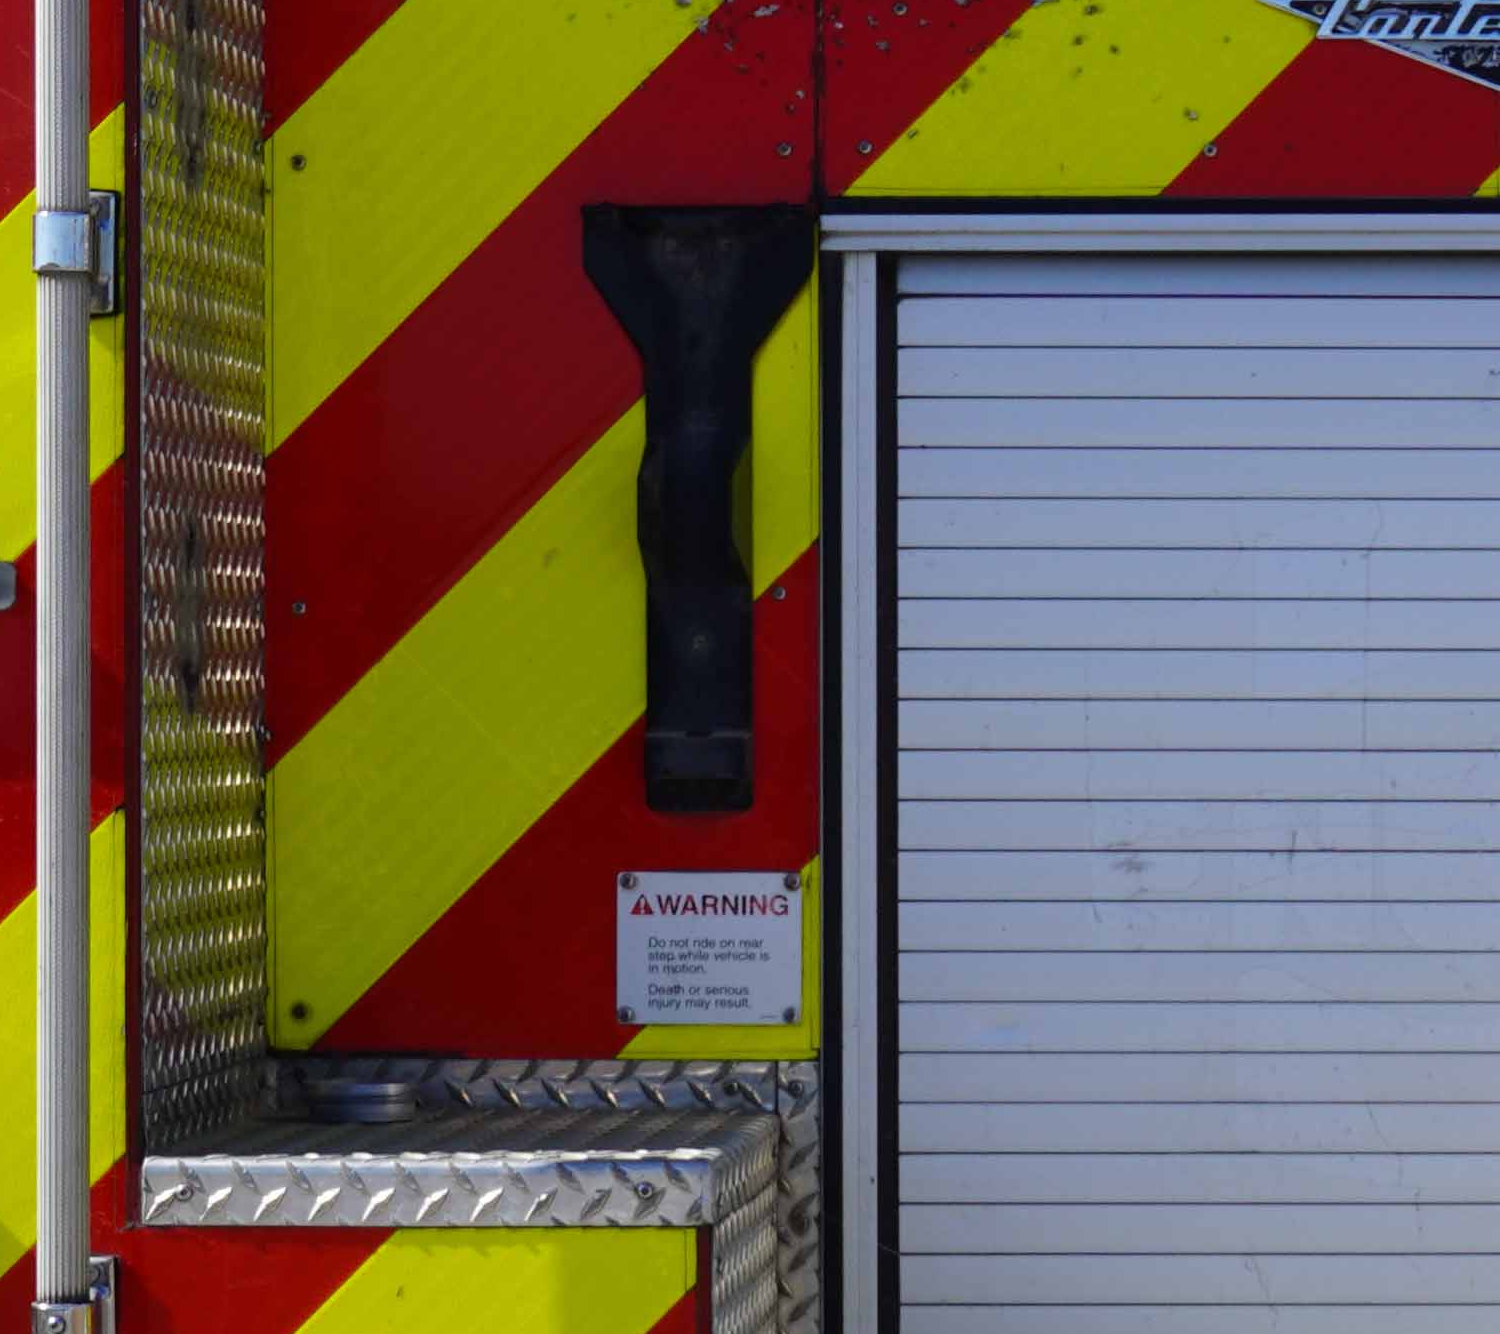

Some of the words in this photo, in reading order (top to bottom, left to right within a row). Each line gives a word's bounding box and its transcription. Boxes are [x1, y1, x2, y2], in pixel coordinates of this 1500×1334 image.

[656, 893, 789, 916] WARNING
[648, 937, 666, 948] Do
[669, 937, 689, 948] not
[692, 937, 716, 948] ride
[719, 939, 736, 948] on
[678, 950, 710, 962] while
[714, 950, 756, 962] vehicle
[759, 951, 771, 962] is
[648, 963, 659, 973] in
[648, 984, 685, 996] Death
[688, 986, 701, 996] or
[704, 985, 750, 996] serious
[648, 997, 681, 1011] injury
[685, 999, 710, 1011] may
